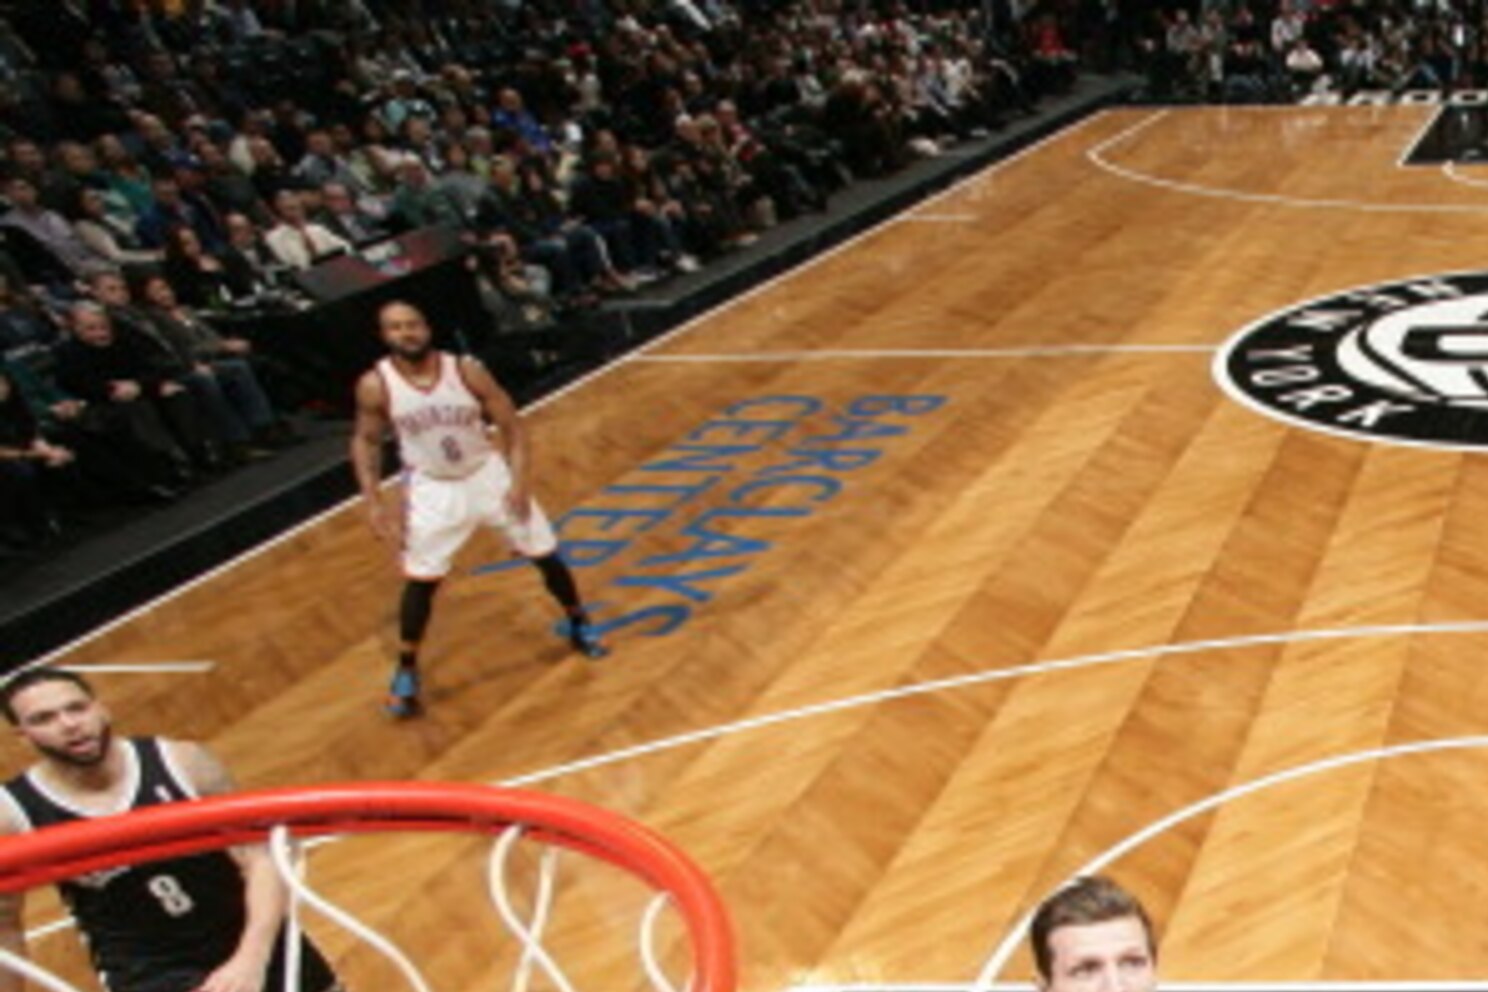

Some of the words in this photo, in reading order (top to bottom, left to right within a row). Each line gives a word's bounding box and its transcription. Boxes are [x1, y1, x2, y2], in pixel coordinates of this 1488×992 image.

[1287, 277, 1463, 331] NEW
[1247, 344, 1416, 428] YORK
[472, 394, 824, 577] CENTER
[578, 394, 950, 637] BARCLAYS
[149, 873, 193, 917] 8
